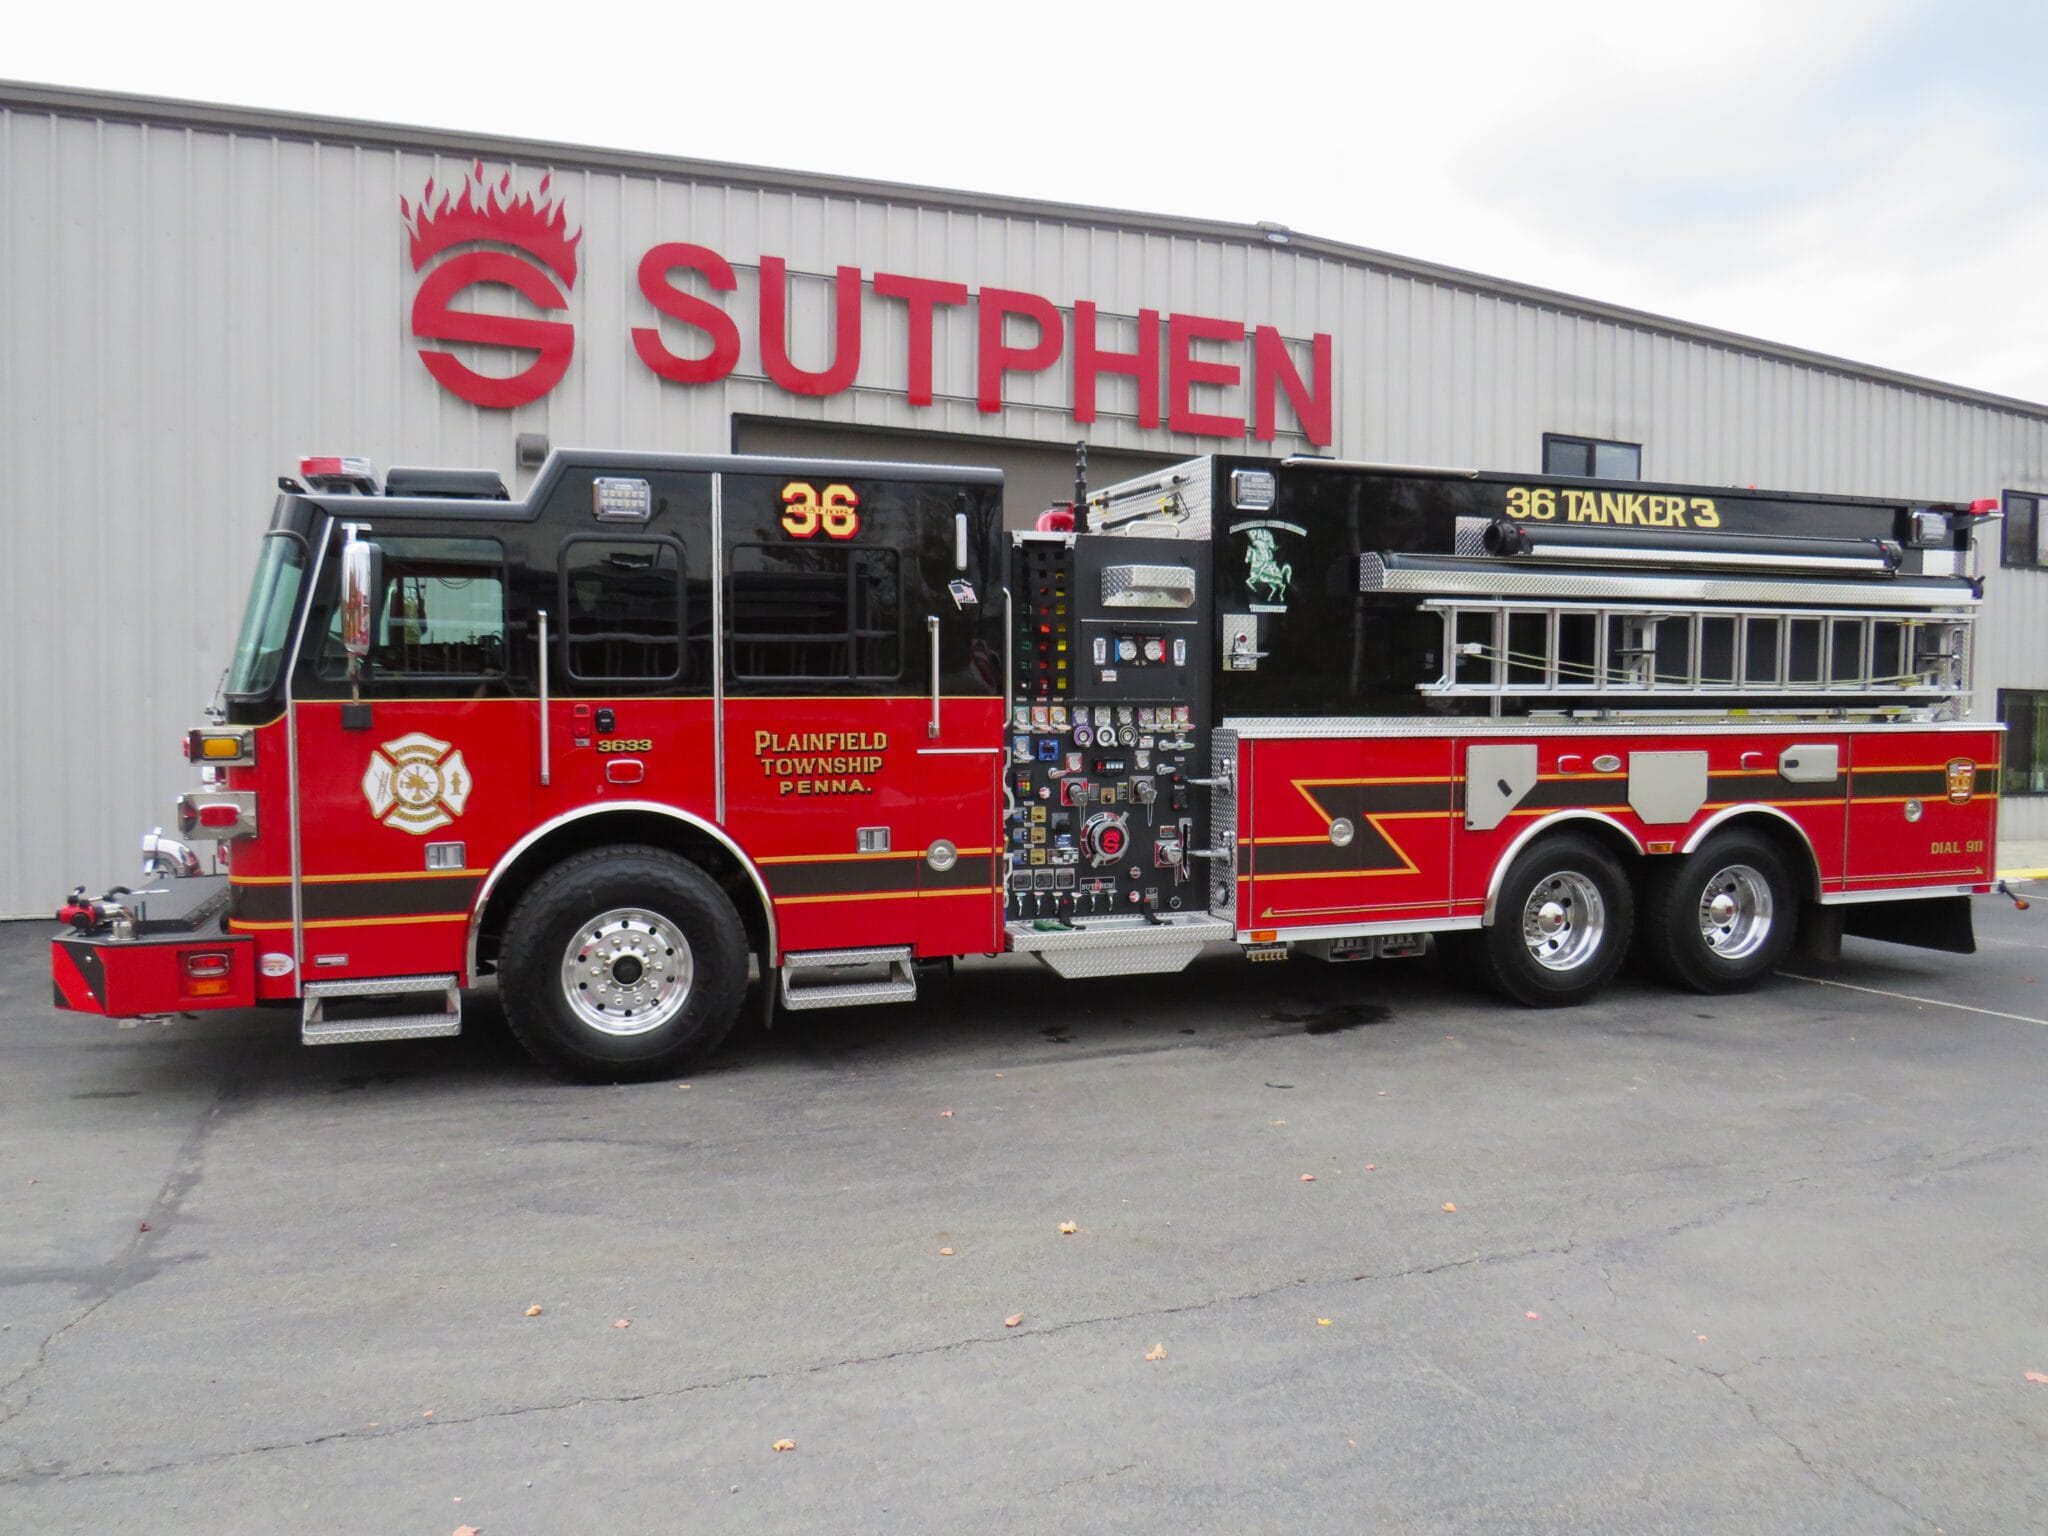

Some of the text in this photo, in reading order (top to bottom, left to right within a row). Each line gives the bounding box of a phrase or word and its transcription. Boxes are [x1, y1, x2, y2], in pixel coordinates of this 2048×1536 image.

[632, 242, 1333, 447] SUTPHEN
[782, 482, 860, 539] 36
[1505, 486, 1720, 528] 36 TANKER 3
[598, 739, 653, 753] 3633
[754, 730, 889, 757] PLAINFIELD
[760, 756, 884, 777] TOWNSHIP
[779, 778, 873, 796] PENNA.
[1931, 840, 1984, 854] DIAL 911
